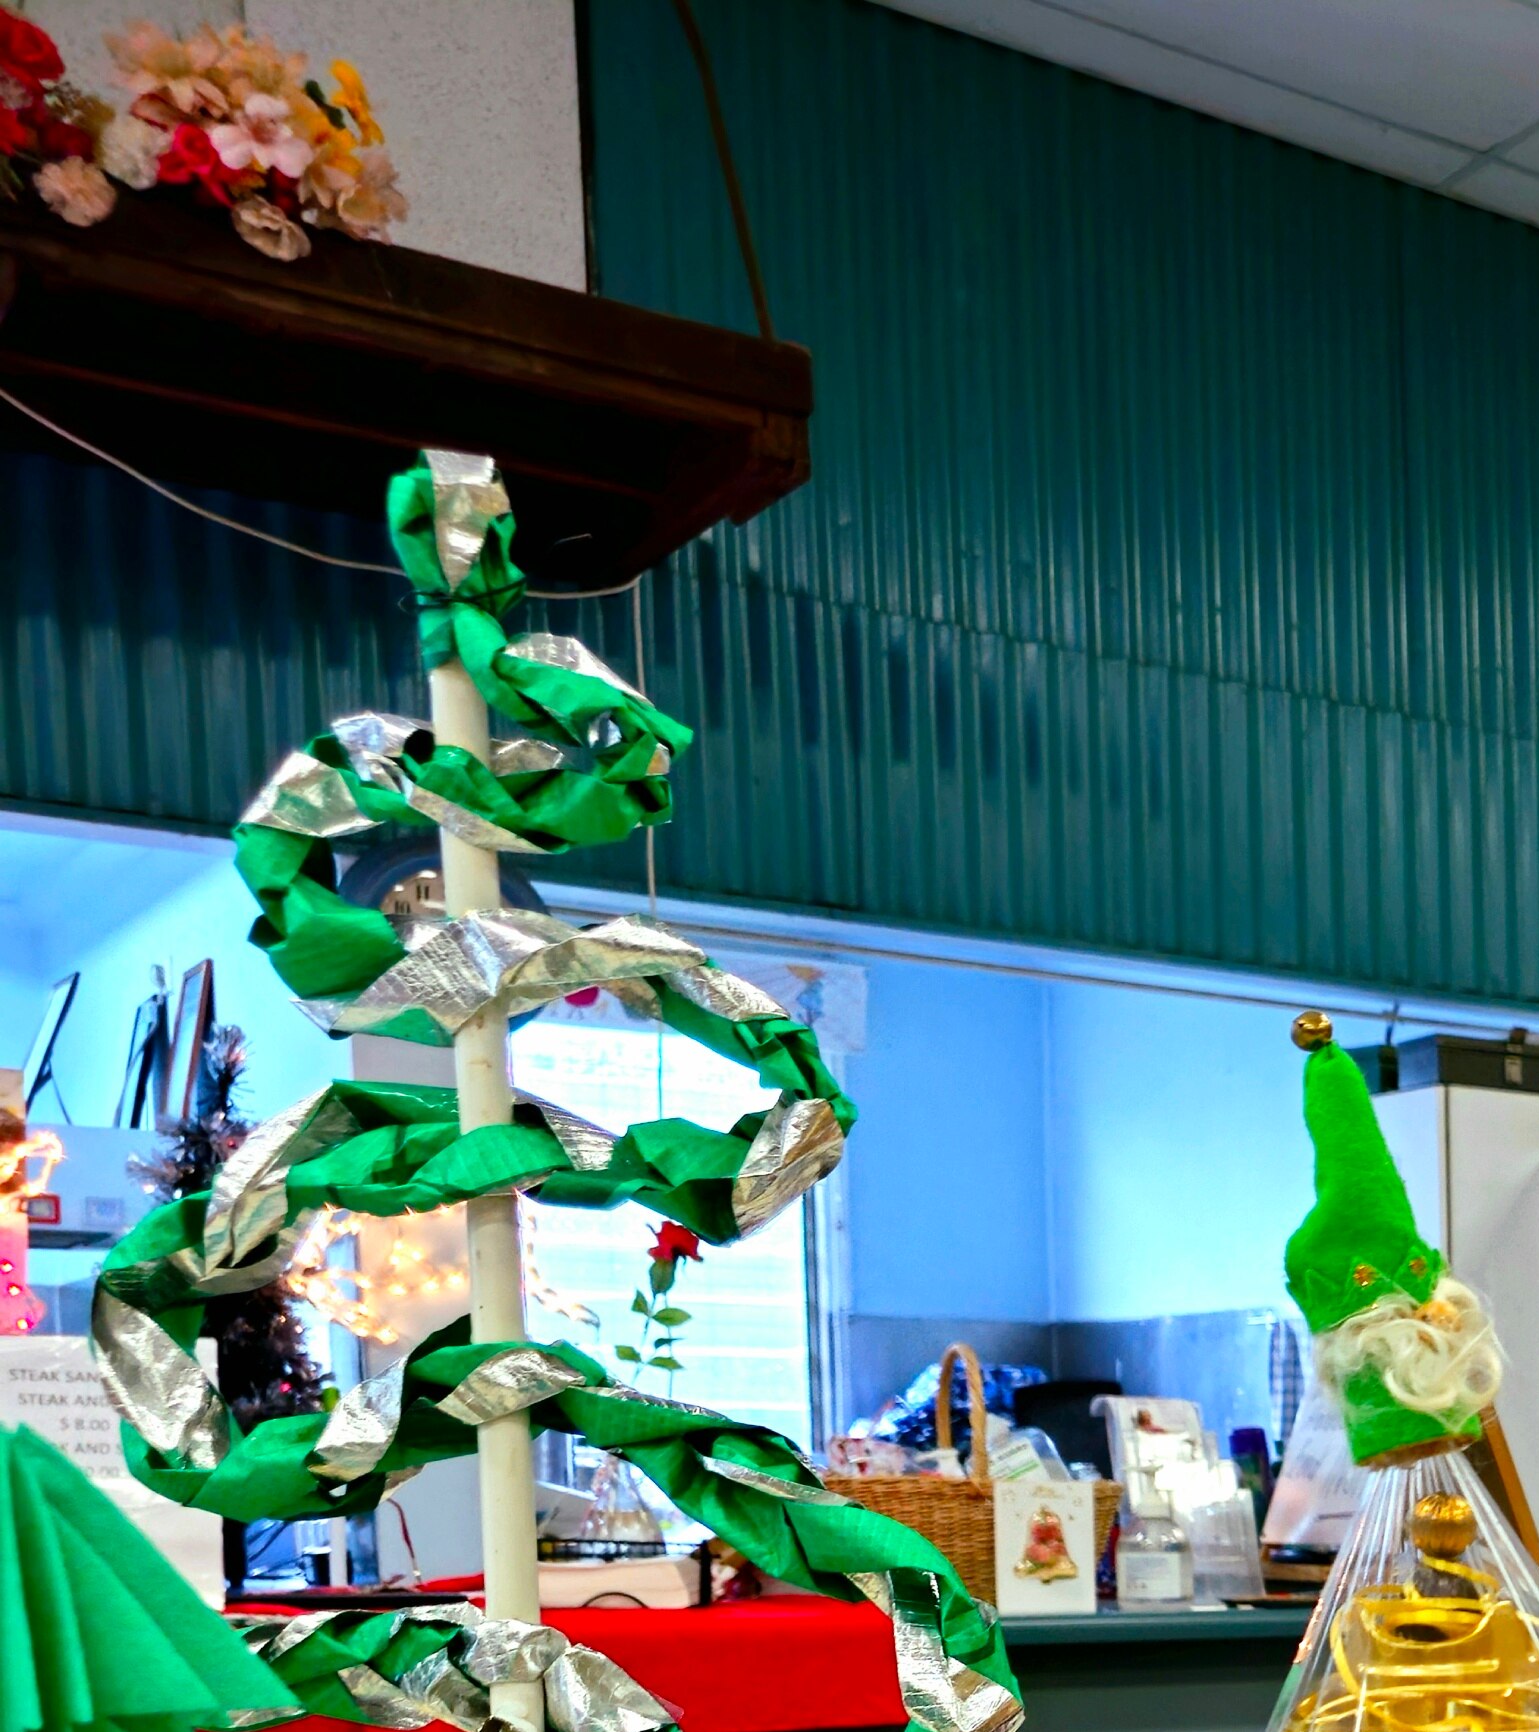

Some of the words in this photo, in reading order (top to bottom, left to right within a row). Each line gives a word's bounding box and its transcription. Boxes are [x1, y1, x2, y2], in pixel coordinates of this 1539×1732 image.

[9, 1369, 58, 1382] STEAK
[66, 1370, 101, 1383] SAN
[18, 1394, 67, 1405] STEAK
[74, 1442, 110, 1455] AND
